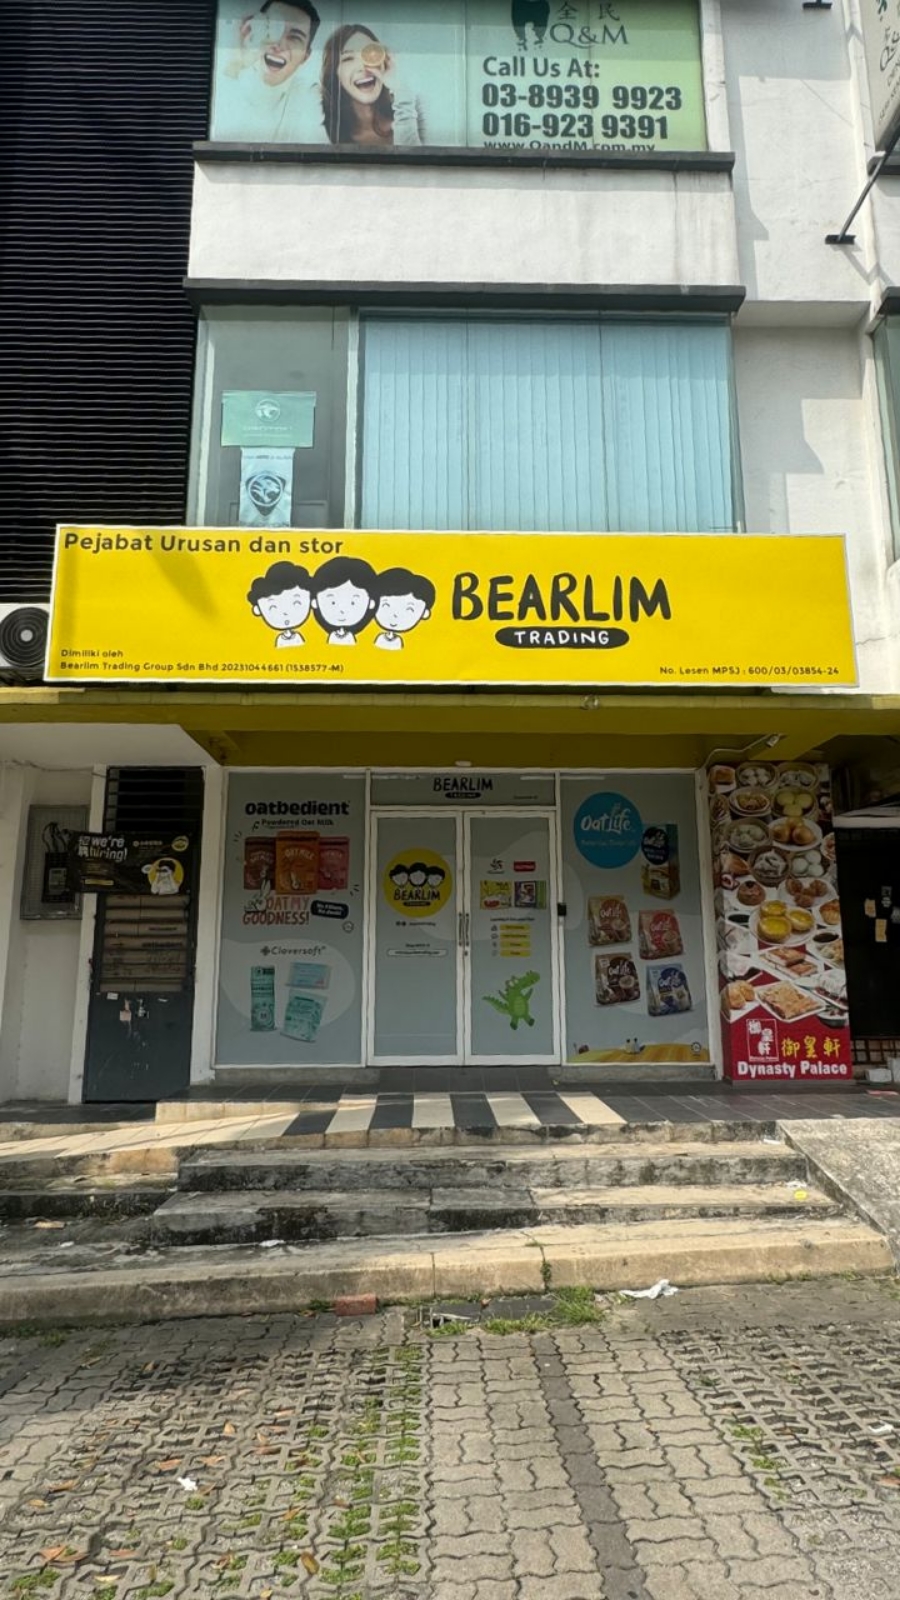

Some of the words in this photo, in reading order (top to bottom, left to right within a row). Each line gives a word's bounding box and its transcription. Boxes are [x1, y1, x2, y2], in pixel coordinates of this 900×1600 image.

[549, 23, 629, 49] Q&M
[482, 56, 525, 77] Call
[533, 57, 559, 78] Us
[566, 58, 600, 79] At:
[482, 83, 599, 109] 03-8939
[612, 85, 682, 110] 9923
[482, 112, 593, 138] 016-923
[602, 115, 668, 139] 9391
[64, 533, 153, 554] Pejabat
[160, 535, 241, 553] Urusan
[249, 536, 291, 553] dan
[299, 537, 343, 554] stor
[452, 571, 672, 623] BEARLIM
[514, 630, 610, 646] TRADING
[60, 649, 99, 657] Dimiliki
[102, 650, 123, 658] oleh
[60, 662, 99, 670] Bearlim
[103, 662, 140, 672] Trading
[143, 662, 174, 672] Group
[176, 663, 196, 671] Sdn
[198, 663, 218, 671] Bhd
[660, 666, 676, 675] No.
[680, 666, 709, 675] Lesen
[712, 666, 740, 675] MPSJ
[433, 777, 493, 791] BEARLIM
[245, 800, 350, 816] oatbedient
[91, 834, 125, 848] we're
[90, 846, 128, 862] hiring!
[393, 889, 441, 901] BEARLIM
[242, 910, 310, 925] GOODNESS!
[737, 1060, 796, 1078] Dynasty
[800, 1060, 847, 1075] Palace
